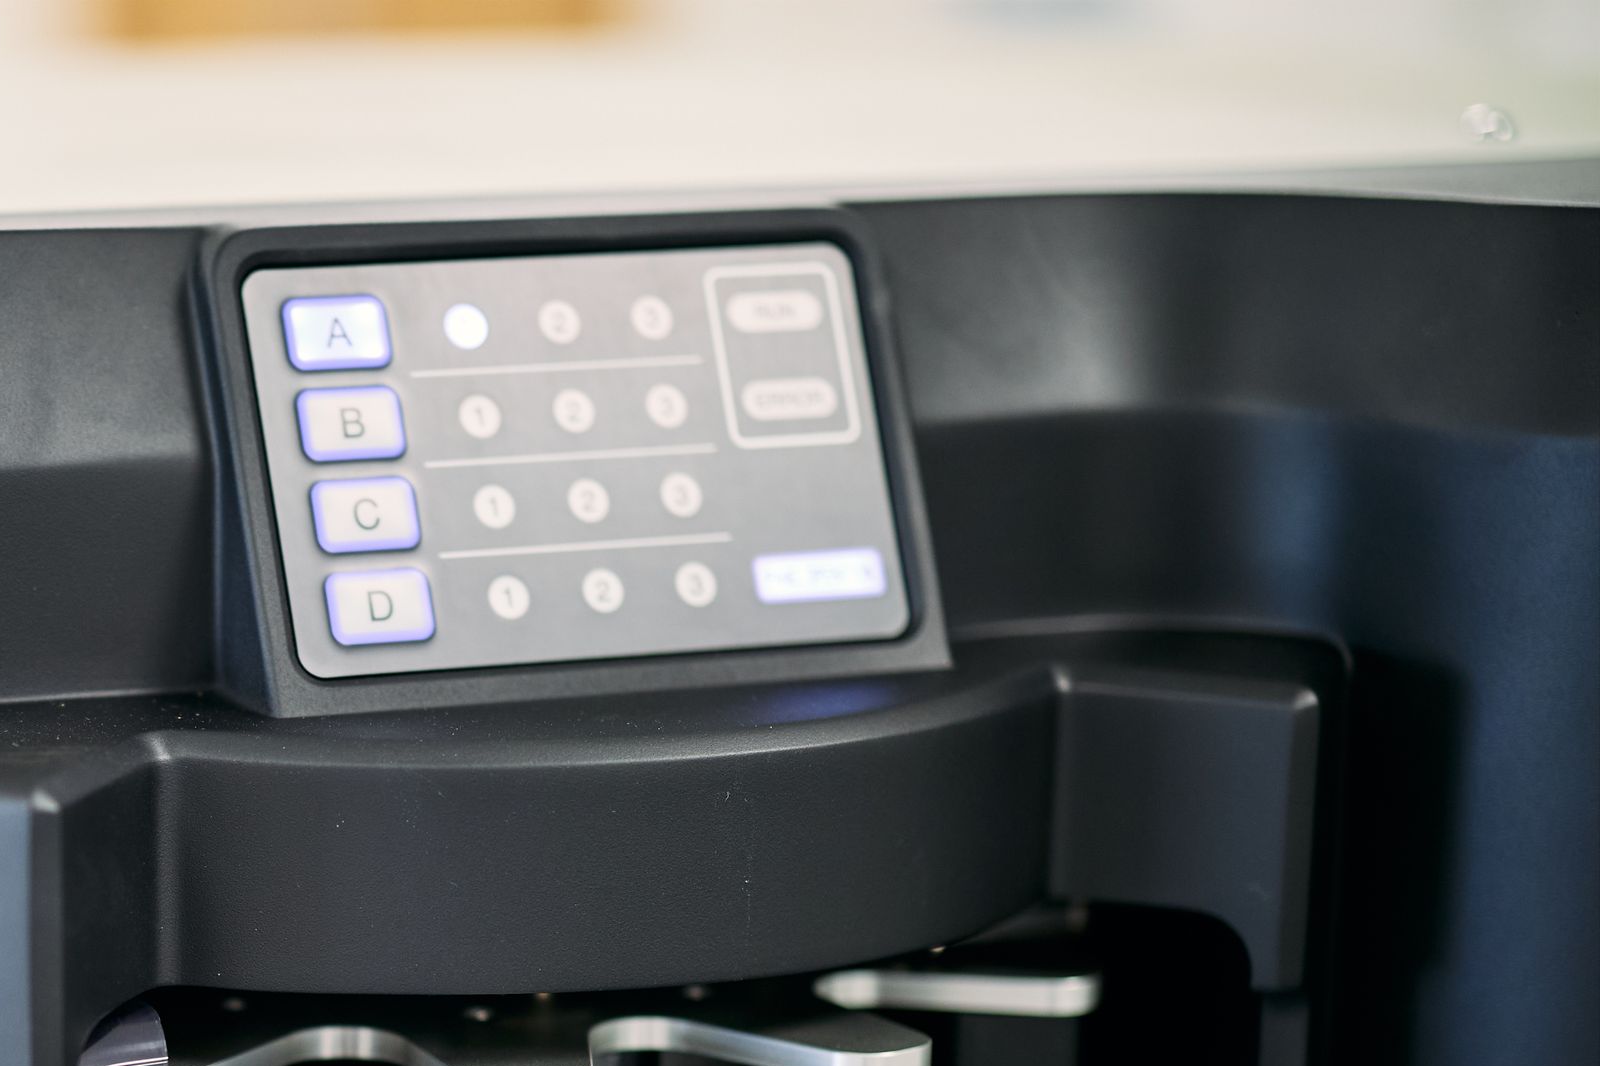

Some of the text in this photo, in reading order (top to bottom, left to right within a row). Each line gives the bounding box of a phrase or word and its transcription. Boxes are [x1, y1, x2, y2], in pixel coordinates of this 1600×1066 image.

[327, 318, 352, 348] A
[553, 311, 567, 333] 2
[340, 408, 365, 438] B
[475, 407, 485, 426] 1
[567, 400, 581, 422] 2
[353, 485, 689, 530] C 1 2 3
[367, 574, 702, 621] D 1 2 3
